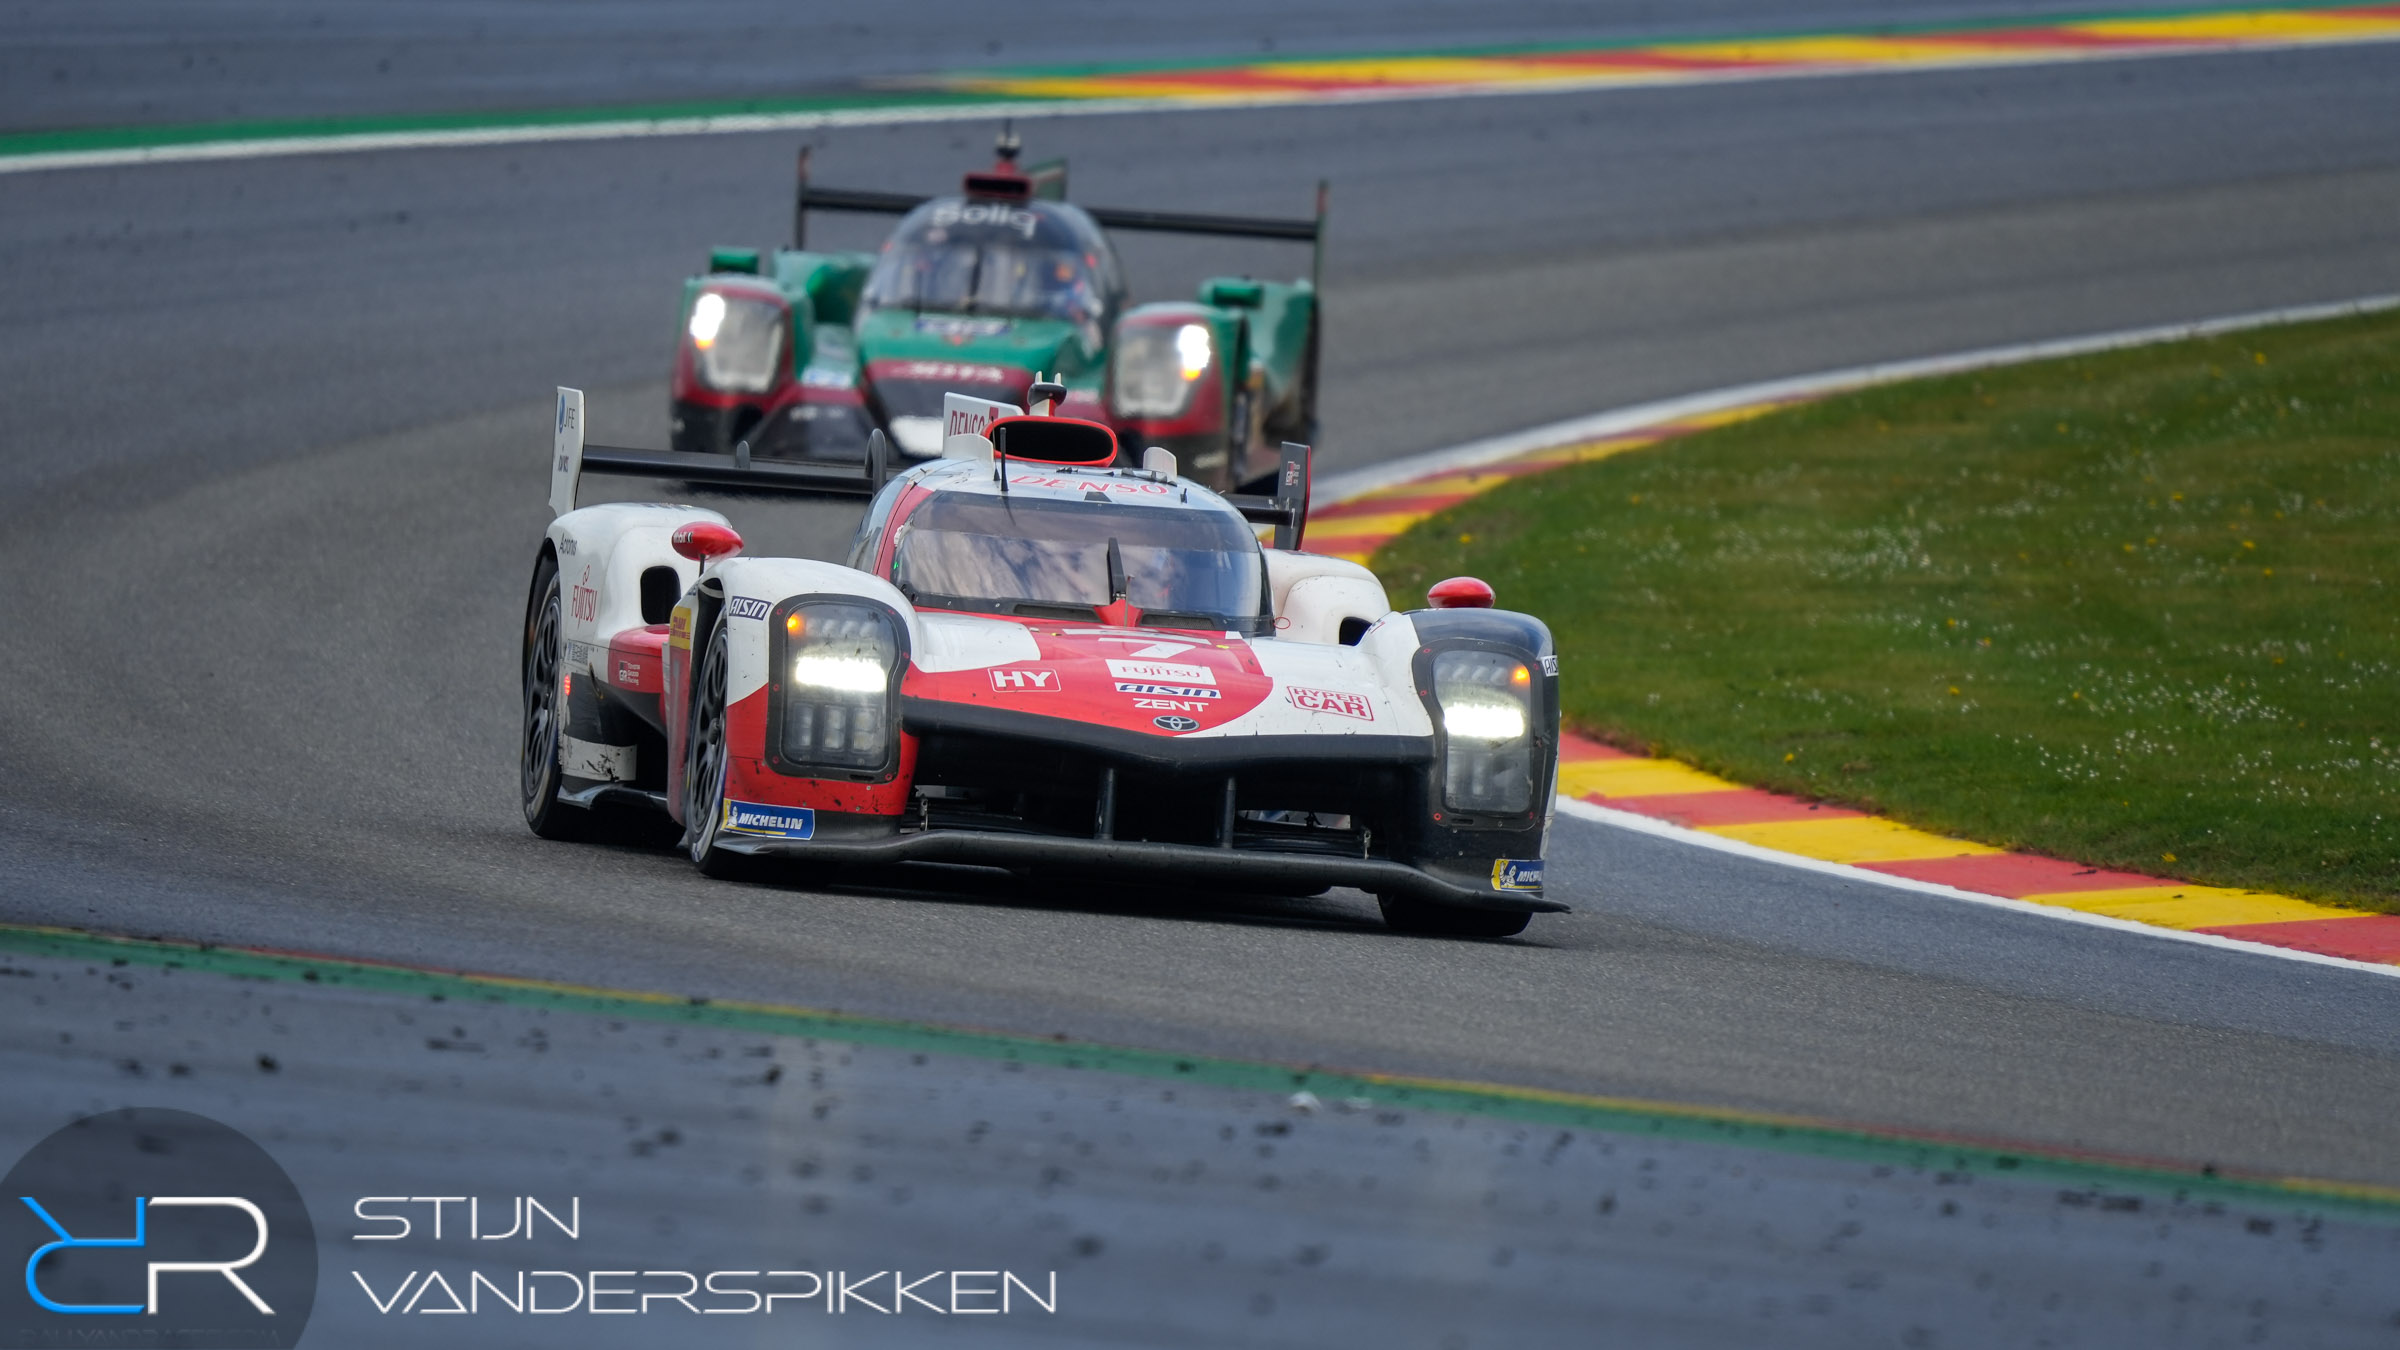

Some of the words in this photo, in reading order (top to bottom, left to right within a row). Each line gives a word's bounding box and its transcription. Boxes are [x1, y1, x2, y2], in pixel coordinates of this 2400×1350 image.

[563, 407, 576, 430] JFE
[1009, 475, 1169, 496] DENSO
[570, 584, 598, 630] FUJITSU
[729, 598, 768, 619] AISIN
[1097, 637, 1197, 659] 7
[992, 670, 1053, 688] HY
[1121, 665, 1201, 679] FUJITSU
[1118, 684, 1218, 698] AISIN
[1293, 688, 1363, 704] HYPER
[1132, 697, 1209, 712] ZENT
[1297, 695, 1367, 717] CAR
[738, 812, 804, 830] MICHELIN
